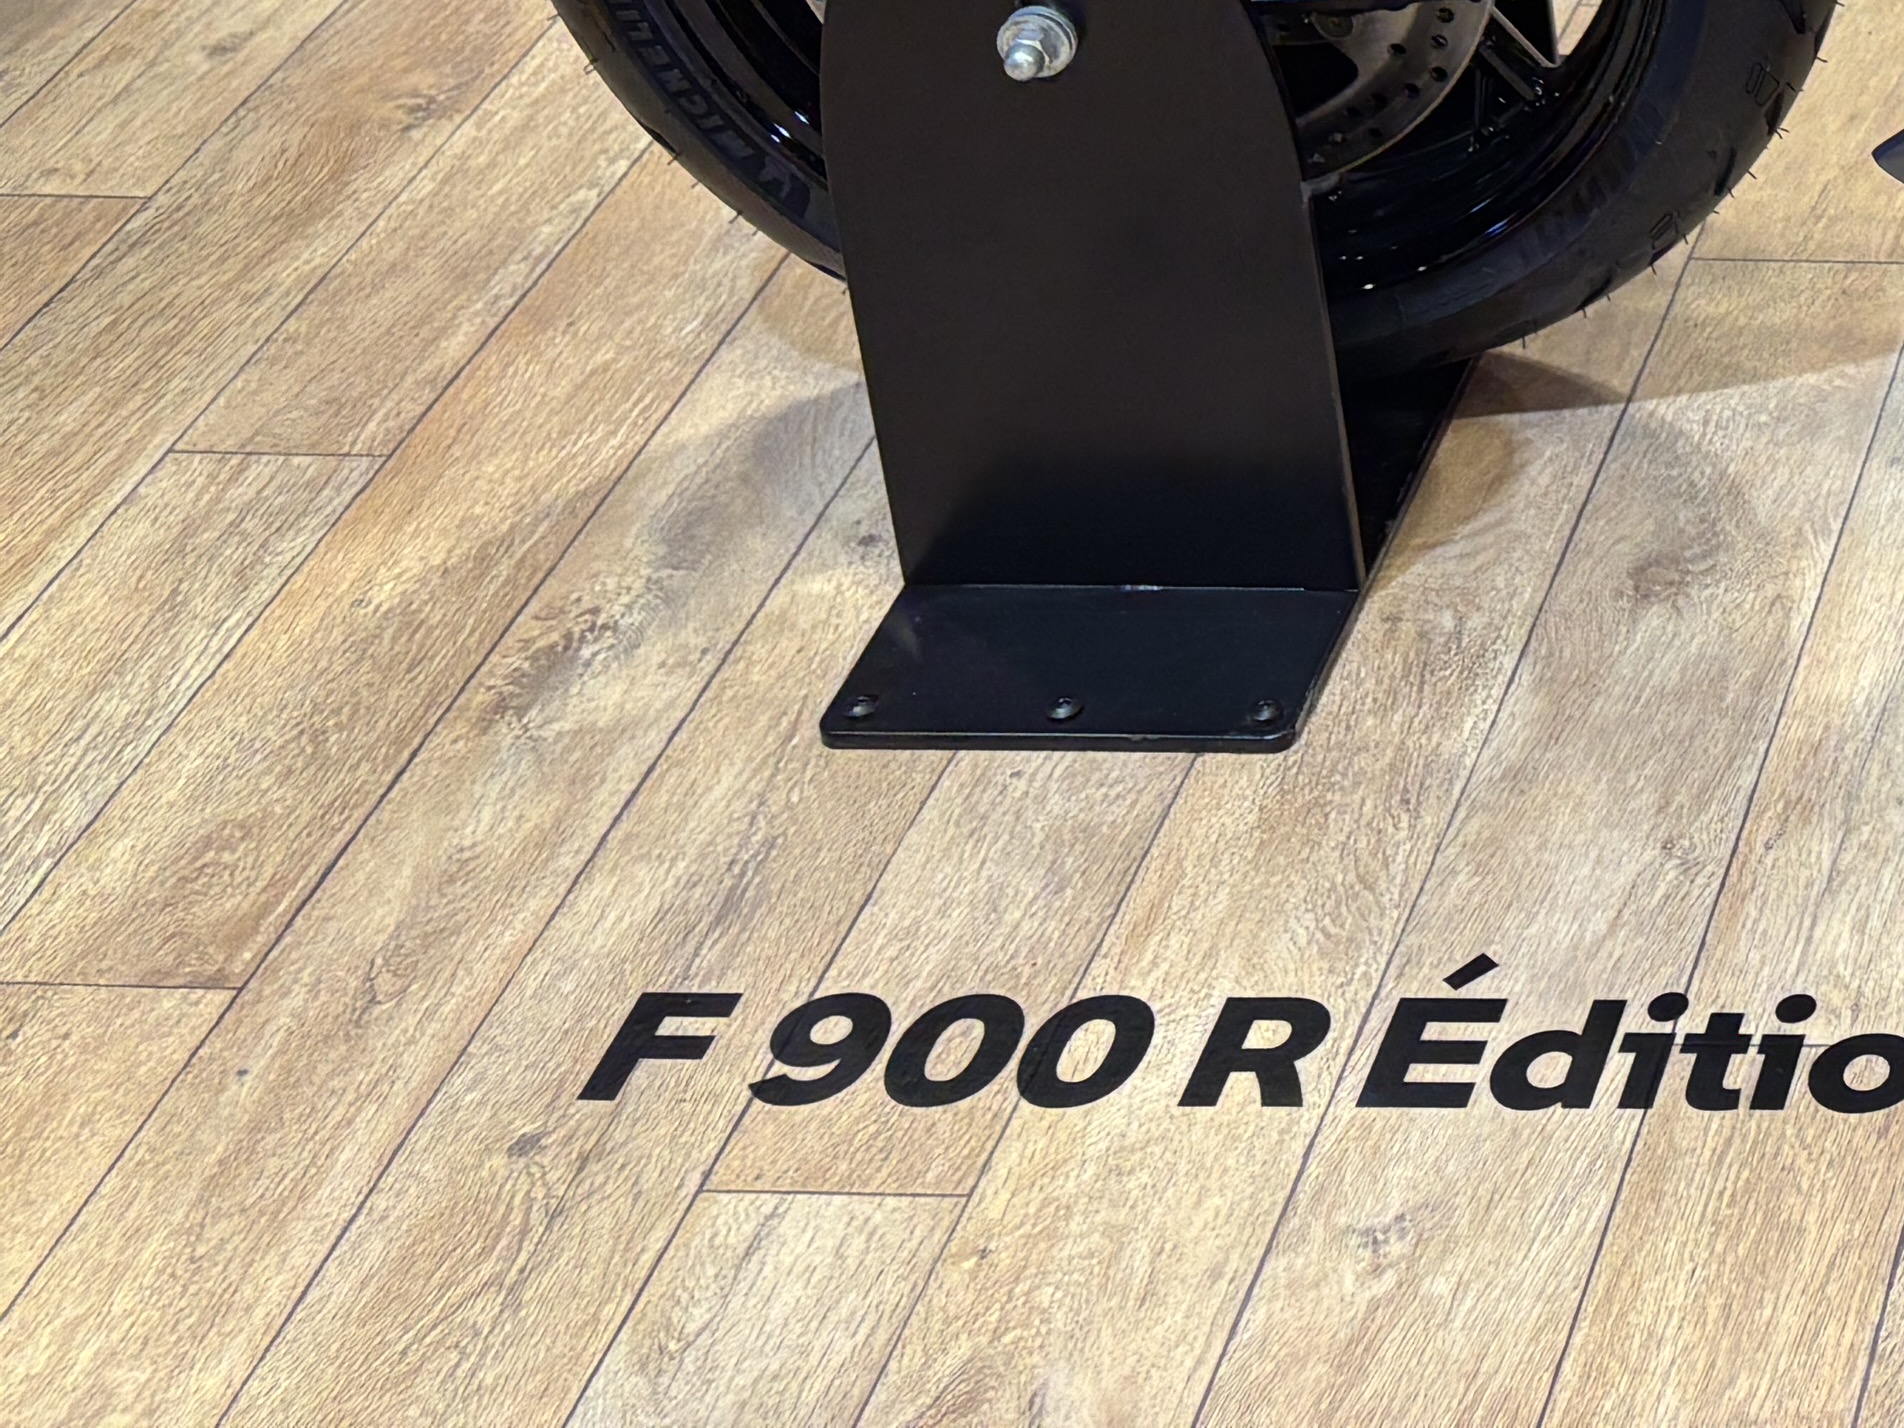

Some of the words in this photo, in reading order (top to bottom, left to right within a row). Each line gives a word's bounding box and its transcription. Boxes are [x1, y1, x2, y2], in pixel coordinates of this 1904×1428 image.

[575, 992, 744, 1102] F
[748, 993, 1156, 1108] 900
[1177, 997, 1332, 1108] R
